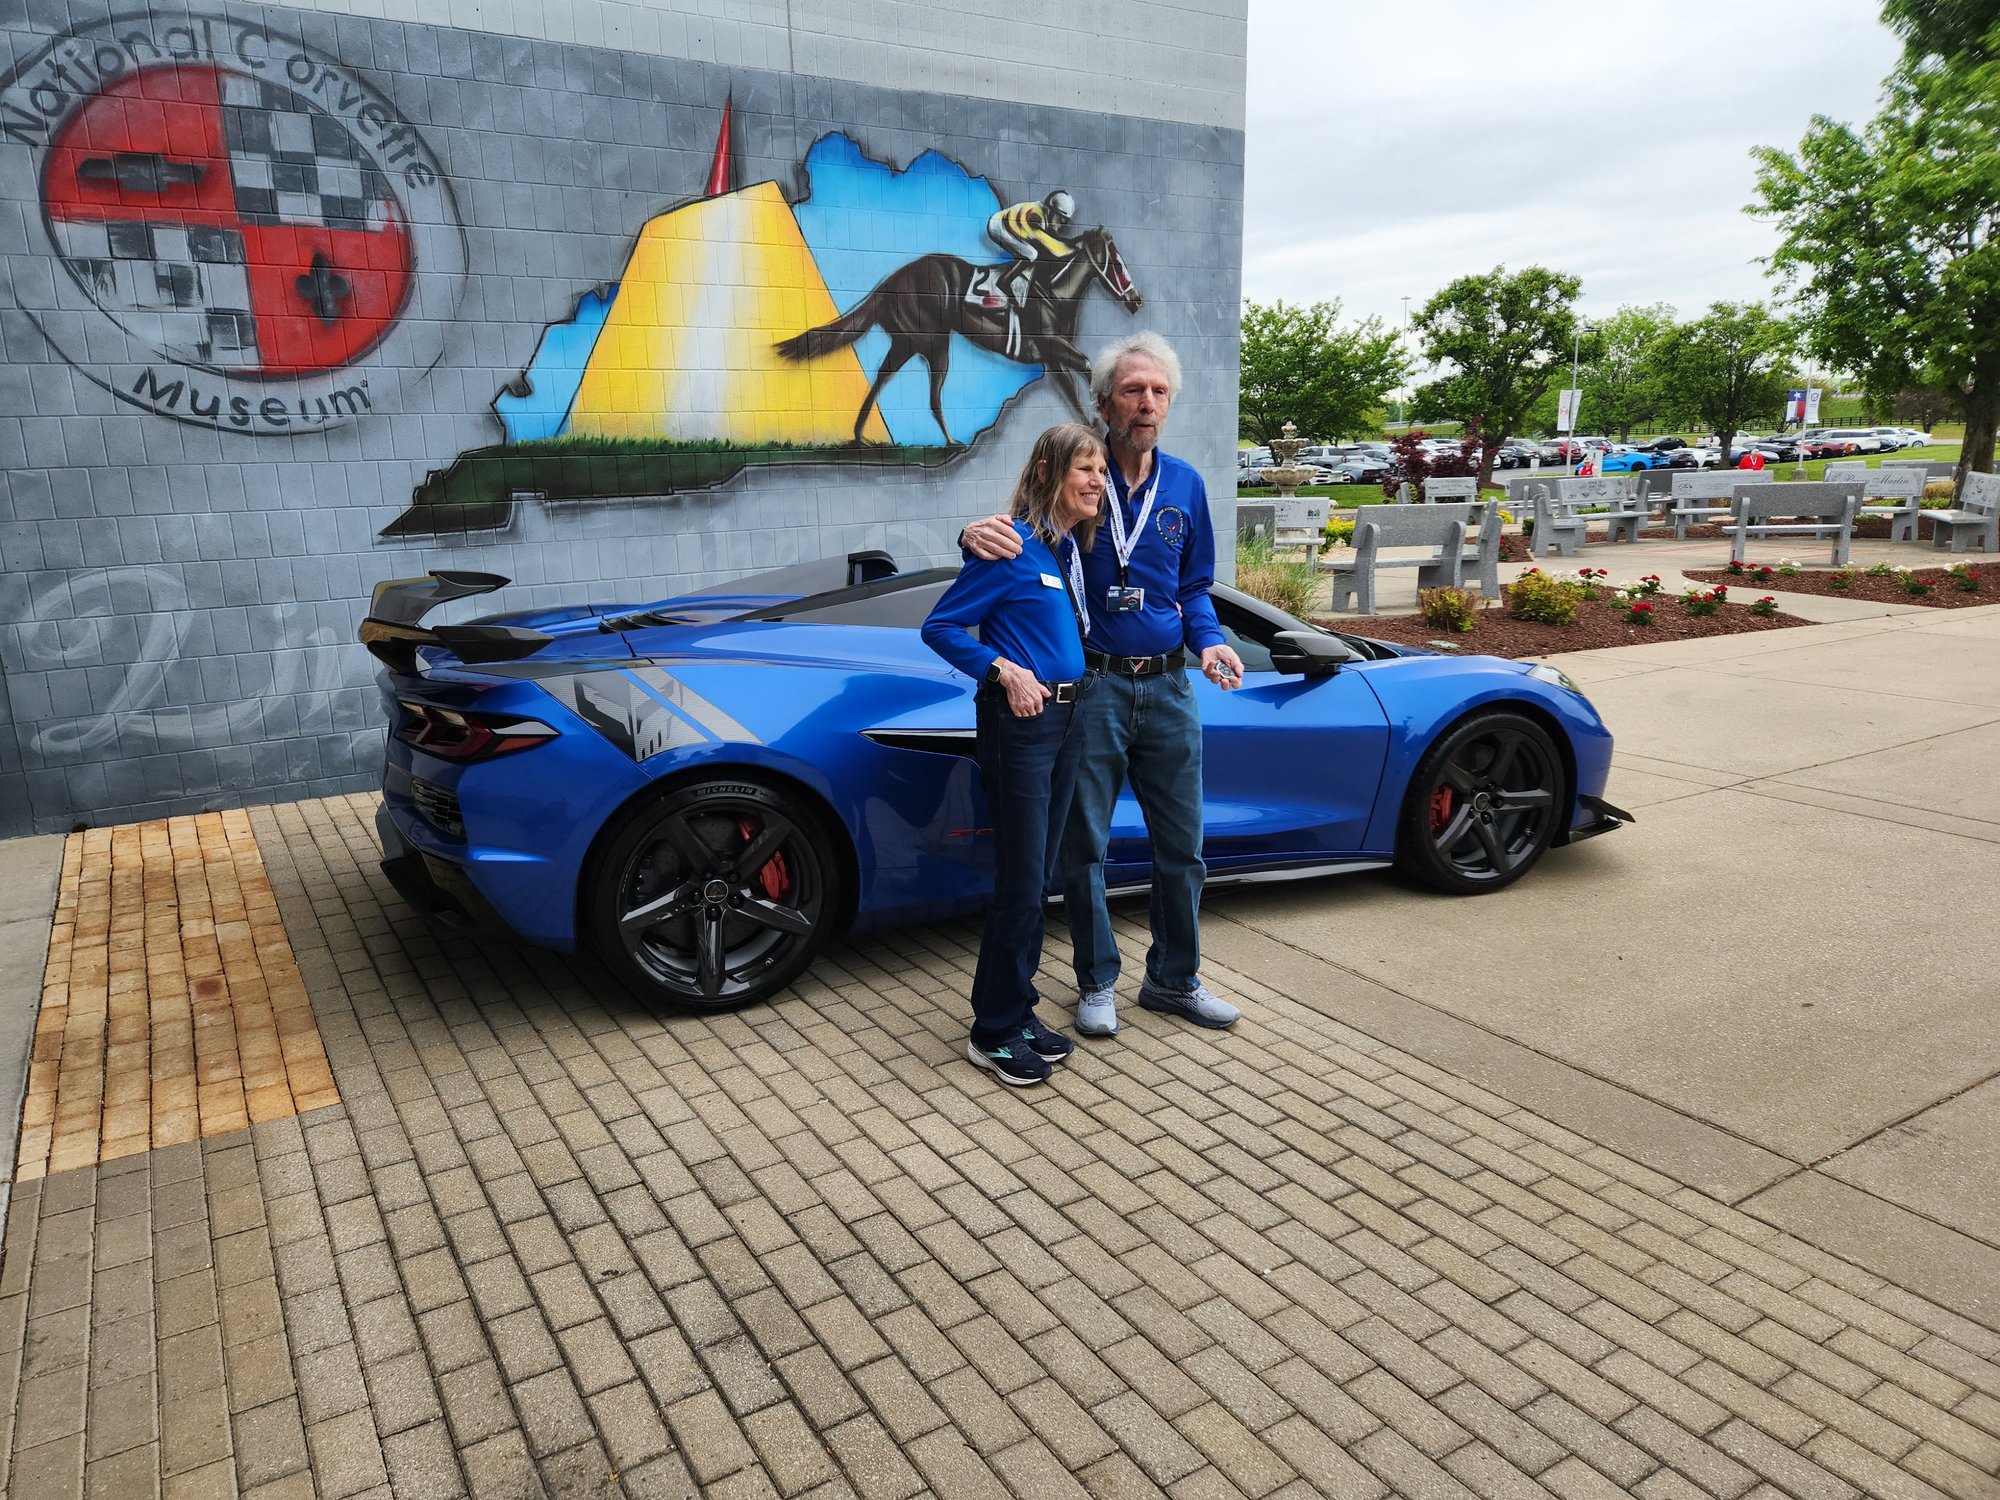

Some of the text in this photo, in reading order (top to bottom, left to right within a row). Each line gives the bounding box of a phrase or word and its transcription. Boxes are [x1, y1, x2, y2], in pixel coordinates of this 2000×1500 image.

[0, 20, 436, 190] National Corvette
[973, 266, 991, 297] 2
[697, 785, 755, 796] MICHELIN
